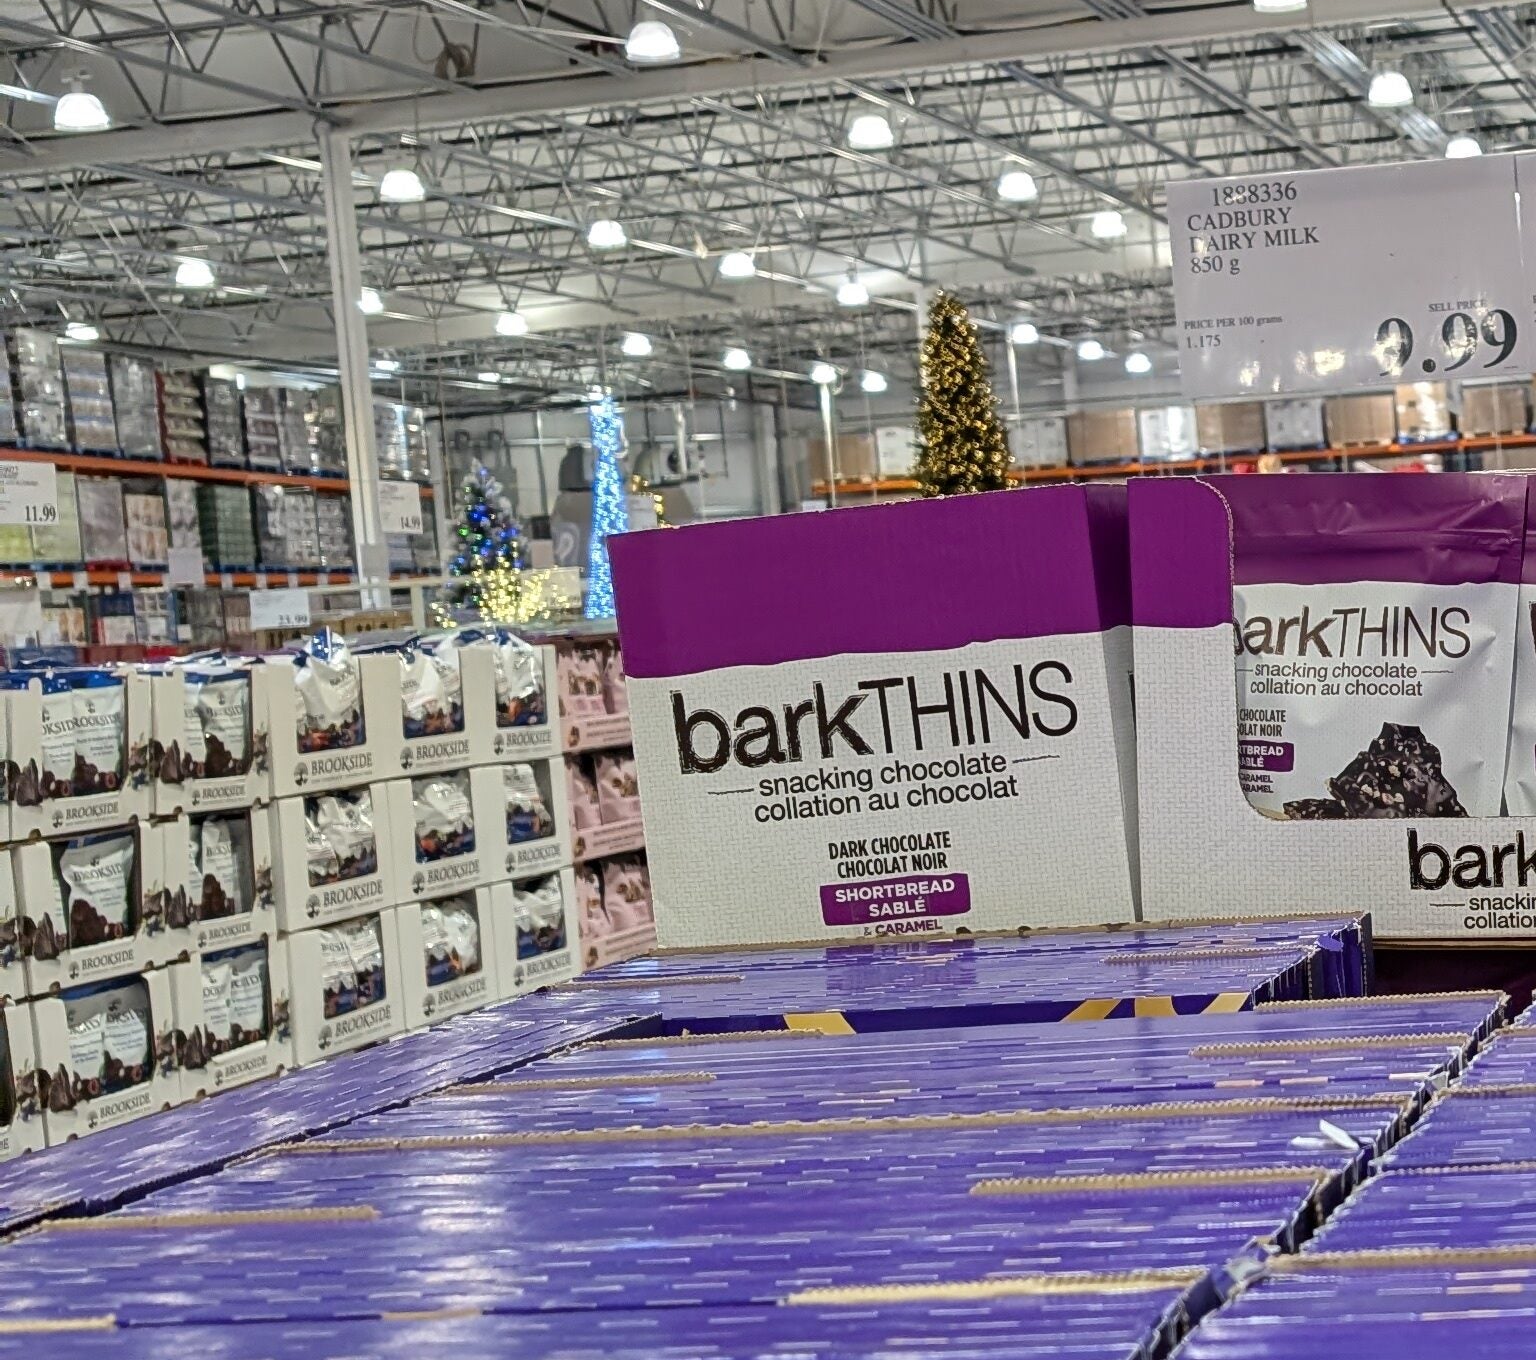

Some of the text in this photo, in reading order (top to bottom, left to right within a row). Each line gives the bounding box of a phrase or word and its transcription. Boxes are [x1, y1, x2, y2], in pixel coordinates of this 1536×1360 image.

[1212, 181, 1297, 206] 1888336
[1187, 207, 1292, 232] CADBURY
[1265, 226, 1319, 247] MILK
[1190, 254, 1240, 274] 850 g
[1429, 299, 1487, 313] SELL PRICE
[1184, 314, 1282, 330] PRICE PER 100 grams
[1186, 335, 1221, 350] 1.175
[25, 504, 56, 522] 11.99
[1255, 662, 1417, 682] snacking chocolate
[1250, 678, 1423, 696] collation au chocolat
[669, 660, 1078, 774] barkTHINS
[1259, 724, 1282, 737] NOIR
[416, 739, 470, 759] BROOKSIDE
[311, 752, 373, 773] BROOKSIDE
[759, 753, 1007, 797] snacking chocolate
[754, 775, 1019, 823] collation au chocolat
[828, 831, 951, 860] DARK CHOCOLATE
[427, 859, 480, 881] BROOKSIDE
[837, 852, 948, 879] CHOCOLAT NOIR
[323, 879, 383, 906] BROOKSIDE
[835, 879, 955, 903] SHORTBREAD
[869, 896, 926, 917] SABLÉ
[82, 949, 134, 970] BROOKSIDE
[335, 1005, 391, 1034] BROOKSIDE
